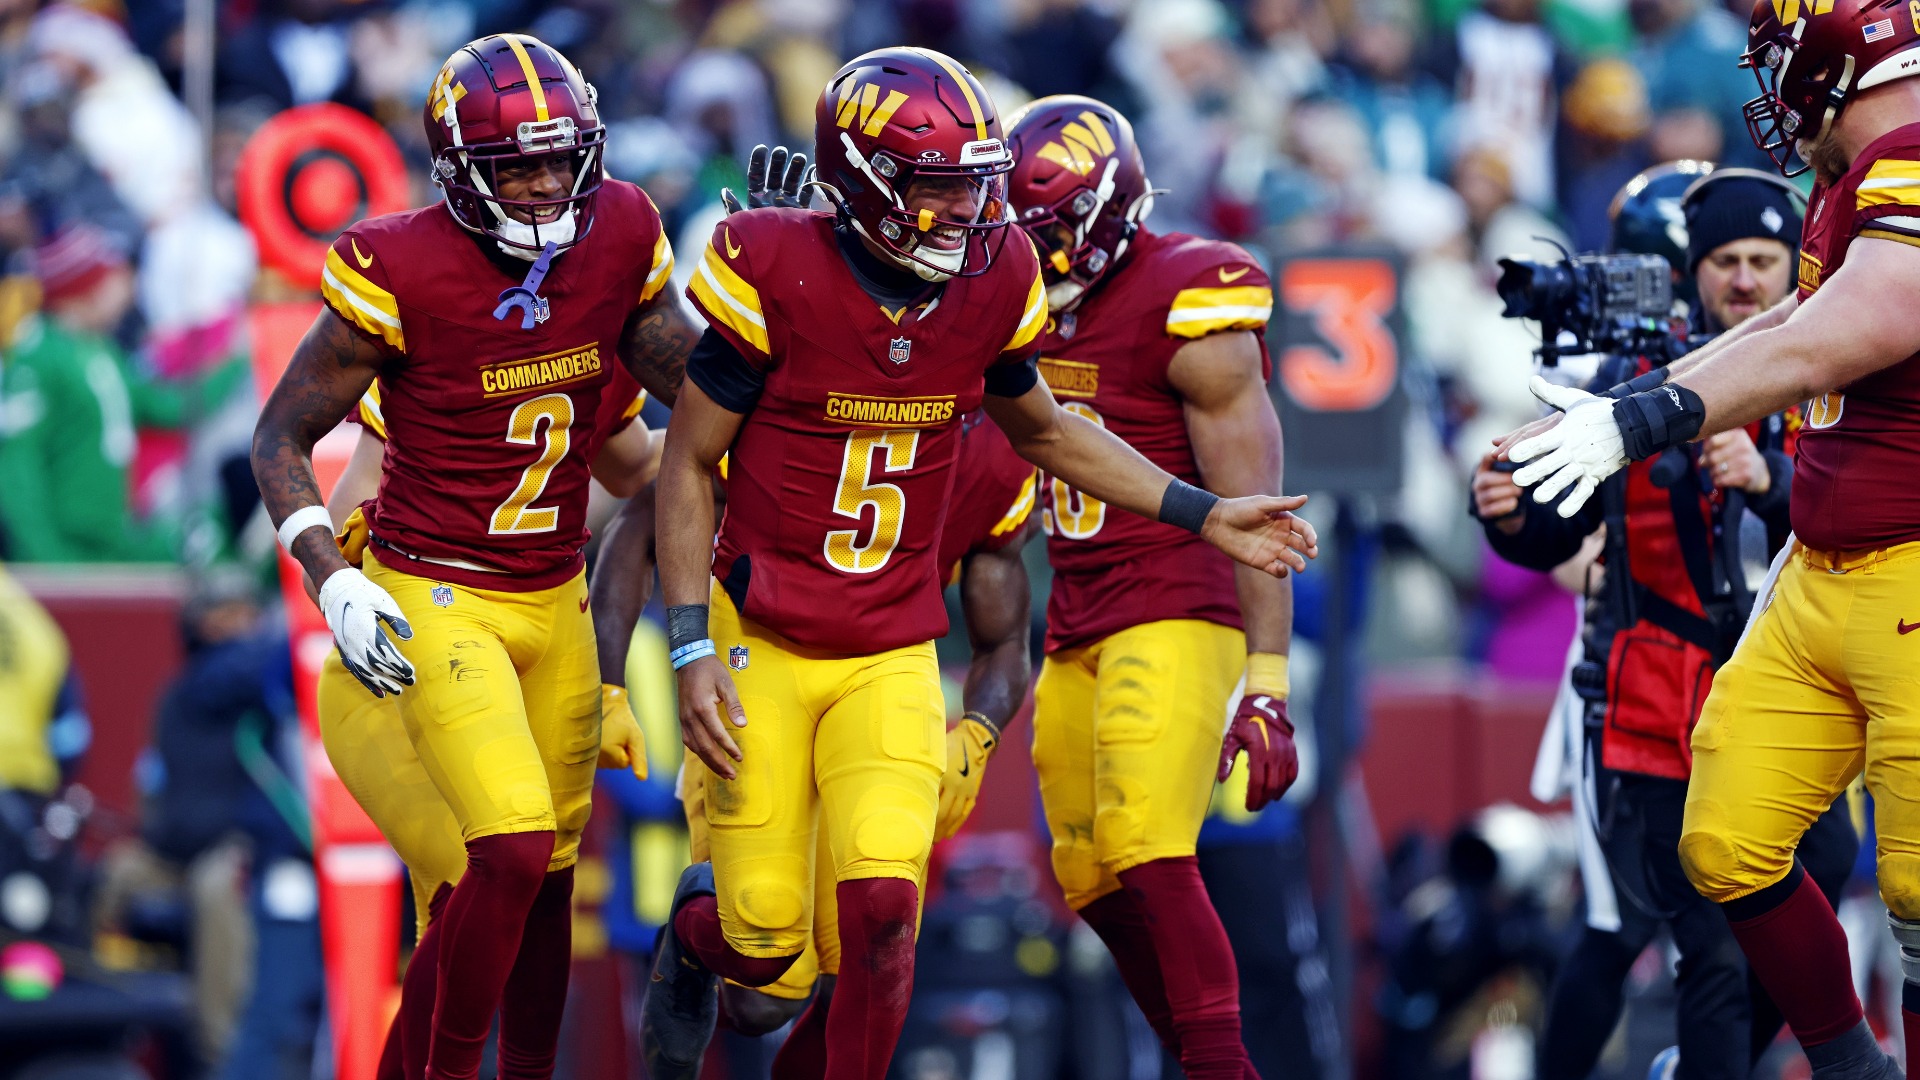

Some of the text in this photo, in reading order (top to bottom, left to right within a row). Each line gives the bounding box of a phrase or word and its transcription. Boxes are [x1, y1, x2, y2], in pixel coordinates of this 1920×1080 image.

[1901, 58, 1920, 69] WA
[970, 143, 1001, 154] COMMANDERS
[1279, 258, 1397, 412] 3
[893, 349, 907, 360] NFL
[482, 348, 600, 393] COMMANDERS
[826, 397, 955, 422] COMMANDERS
[488, 393, 575, 535] 2
[823, 429, 920, 574] 5
[436, 594, 451, 603] NFL
[731, 655, 746, 667] NFL
